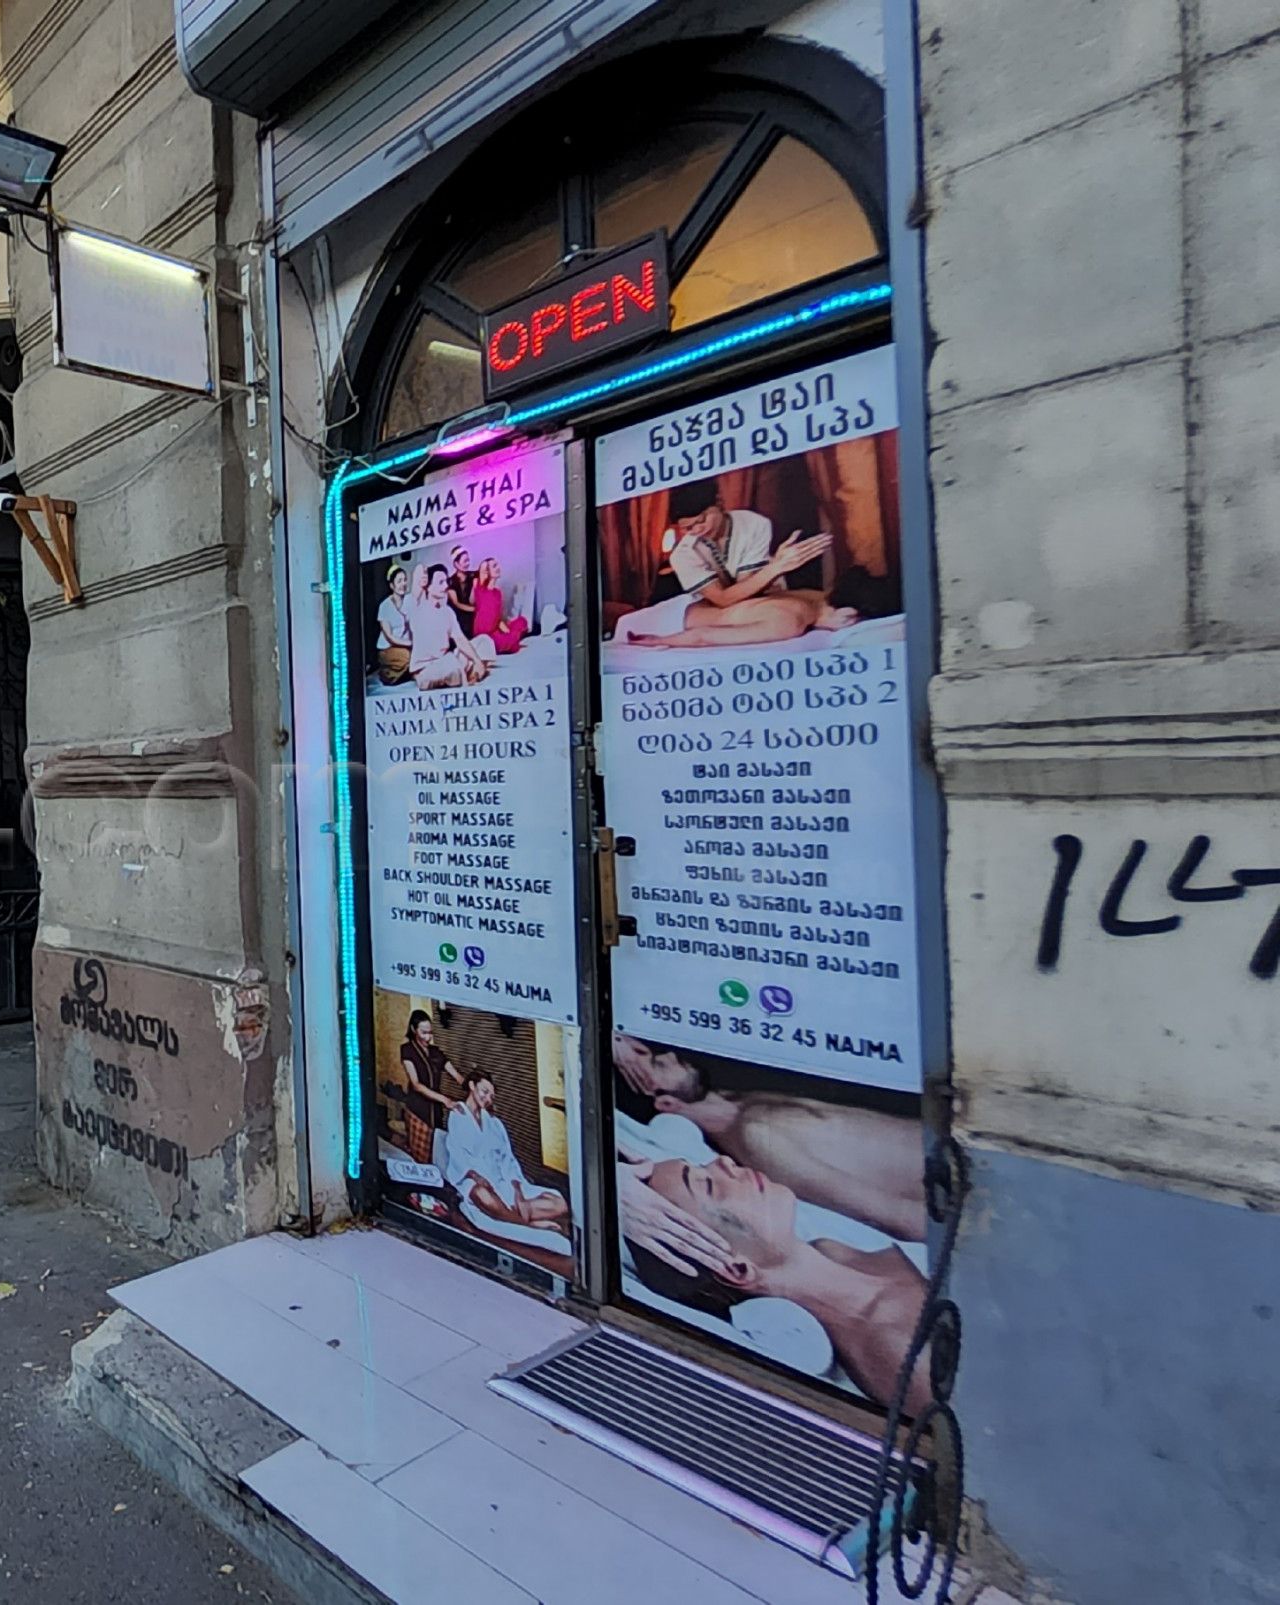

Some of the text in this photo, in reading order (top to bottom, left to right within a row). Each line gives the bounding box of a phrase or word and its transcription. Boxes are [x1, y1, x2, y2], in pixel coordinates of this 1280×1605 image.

[489, 259, 656, 372] OPEN
[649, 372, 835, 454] ნაჯმა ტაი
[622, 399, 875, 492] მასაჟი და სპა
[387, 469, 522, 525] NAJMA THAI
[369, 489, 551, 554] MASSAGE & SPA
[732, 658, 795, 685] ტაი
[804, 652, 869, 678] სპა
[883, 647, 896, 671] 1
[374, 683, 553, 716] NAJMA THAI SPA 1
[732, 689, 794, 714] ტაი
[804, 684, 868, 709] სპა
[877, 680, 899, 704] 2
[375, 709, 556, 738] NAJMA THAI SPA 2
[389, 740, 537, 763] OPEN 24 HOURS
[637, 722, 878, 755] ღიაა 24 საათი
[413, 770, 506, 785] THAI MASSAGE
[692, 761, 812, 779] ტაი მასაჟი
[418, 791, 501, 806] OIL MASSAGE
[661, 788, 851, 804] ზეთოვანი მასაჟი
[408, 811, 514, 827] SPORT MASSAGE
[664, 814, 850, 833] სპორტული მასაჟი
[407, 831, 517, 849] AROMA MASSAGE
[684, 840, 829, 860] არომა მასაჟი
[413, 851, 511, 870] FOOT MASSAGE
[383, 868, 553, 895] BACK SHOULDER MASSAGE
[685, 865, 828, 888] ფეხის მასაჟი
[407, 890, 521, 914] HOT OIL MASSAGE
[631, 885, 904, 922] მხრების და ზურგის მასაჟი
[391, 907, 546, 939] SYMPTOMATIC MASSAGE
[655, 912, 871, 948] ცხელი ზეთის მასაჟი
[816, 954, 900, 979] მასაჟი
[391, 962, 553, 1004] +995 599 36 32 45 NAJMA
[639, 1003, 904, 1064] +995 599 36 32 45 NAJMA
